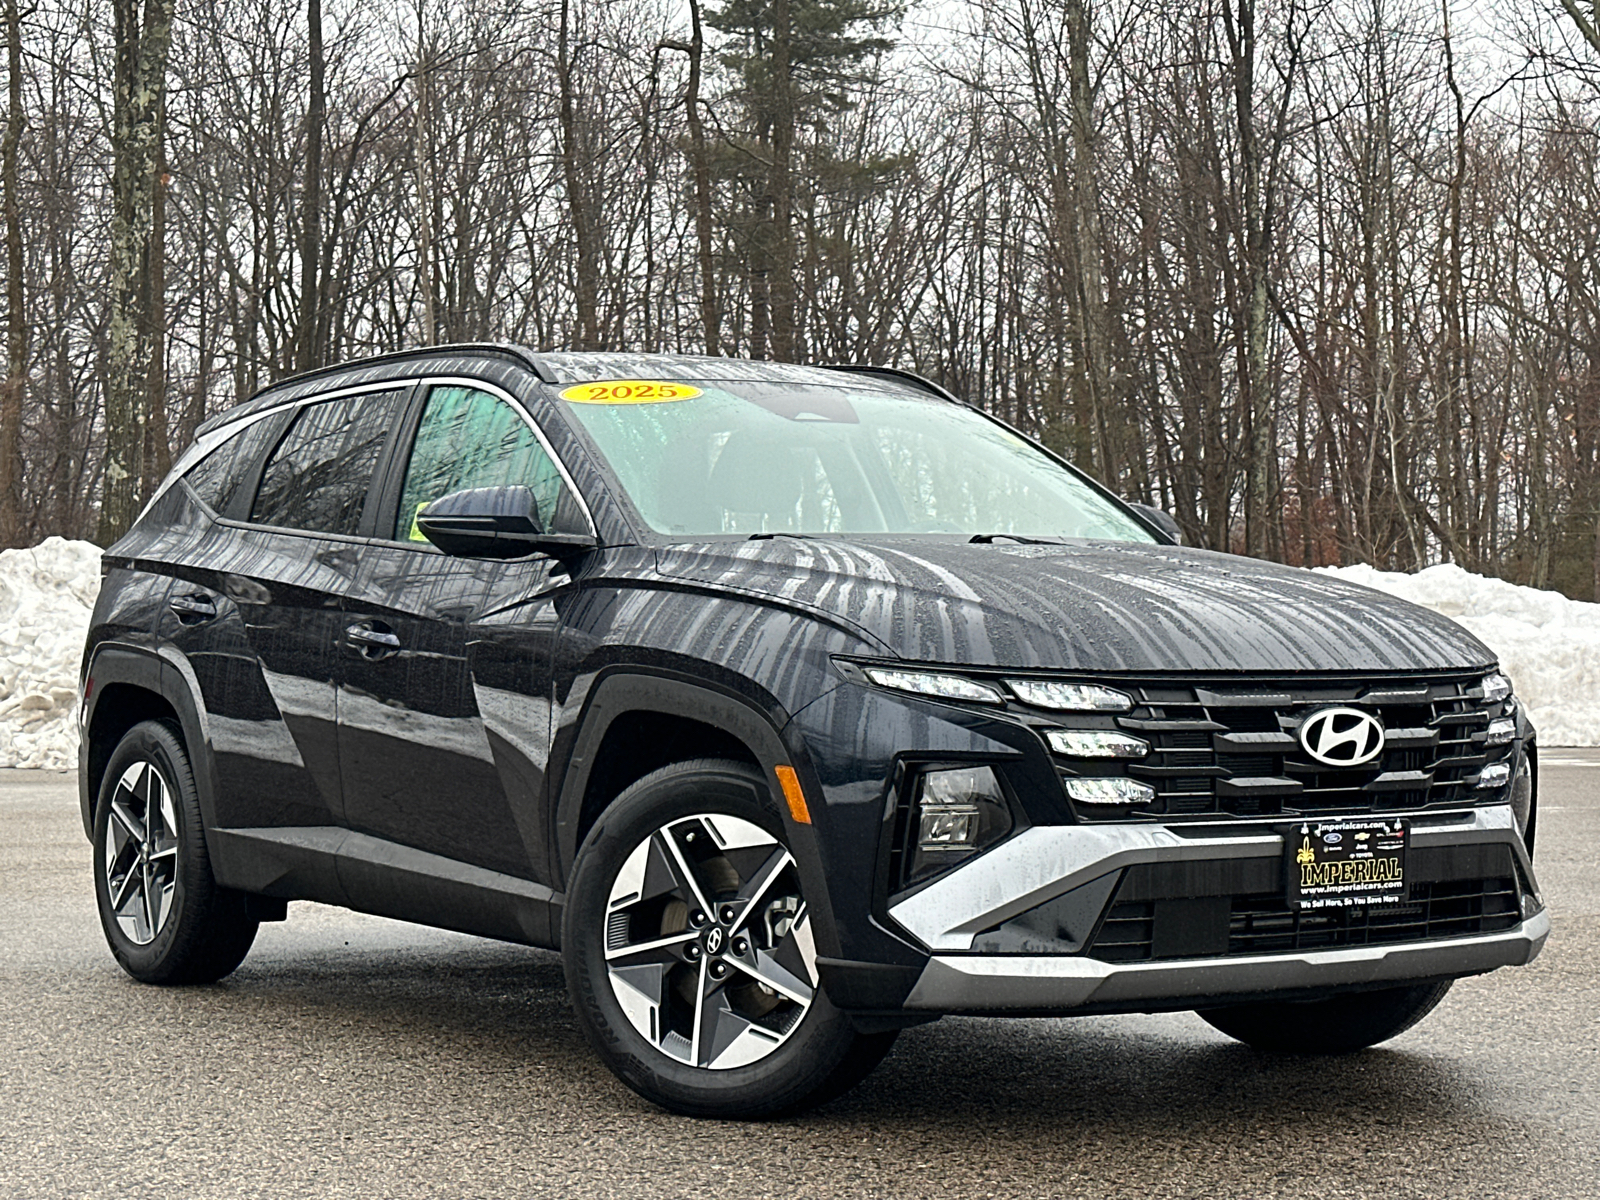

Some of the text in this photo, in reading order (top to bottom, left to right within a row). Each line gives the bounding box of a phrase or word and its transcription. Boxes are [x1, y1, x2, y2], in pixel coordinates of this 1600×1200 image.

[588, 385, 678, 400] 2025
[1300, 858, 1403, 886] IMPERIAL
[1312, 900, 1324, 908] Sell
[1354, 897, 1366, 905] You
[1367, 896, 1382, 904] Save
[1383, 895, 1399, 903] More
